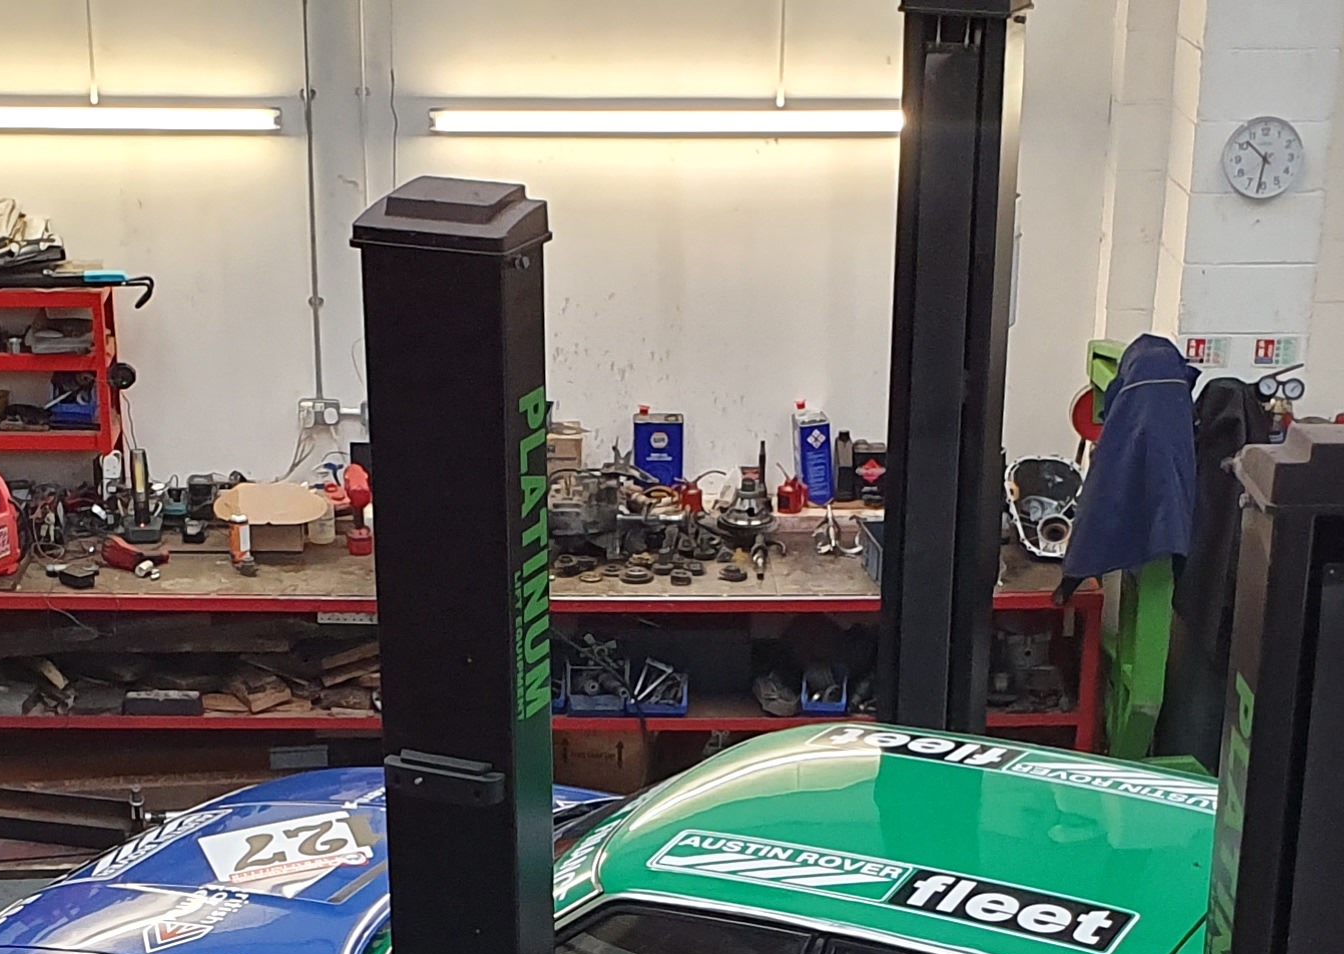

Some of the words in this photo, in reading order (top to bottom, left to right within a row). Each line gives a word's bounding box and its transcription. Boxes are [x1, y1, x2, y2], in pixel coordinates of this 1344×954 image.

[1234, 155, 1242, 165] 9
[1285, 139, 1293, 149] 2
[1287, 153, 1295, 162] 3
[1273, 176, 1281, 186] 5
[518, 385, 551, 719] PLATINUM
[829, 728, 1009, 767] fleet
[1012, 762, 1111, 789] ROVER
[233, 819, 349, 873] 27
[678, 835, 791, 859] AUSTIN
[794, 851, 903, 880] ROVER
[199, 893, 249, 925] ritish
[906, 875, 1113, 946] fleet
